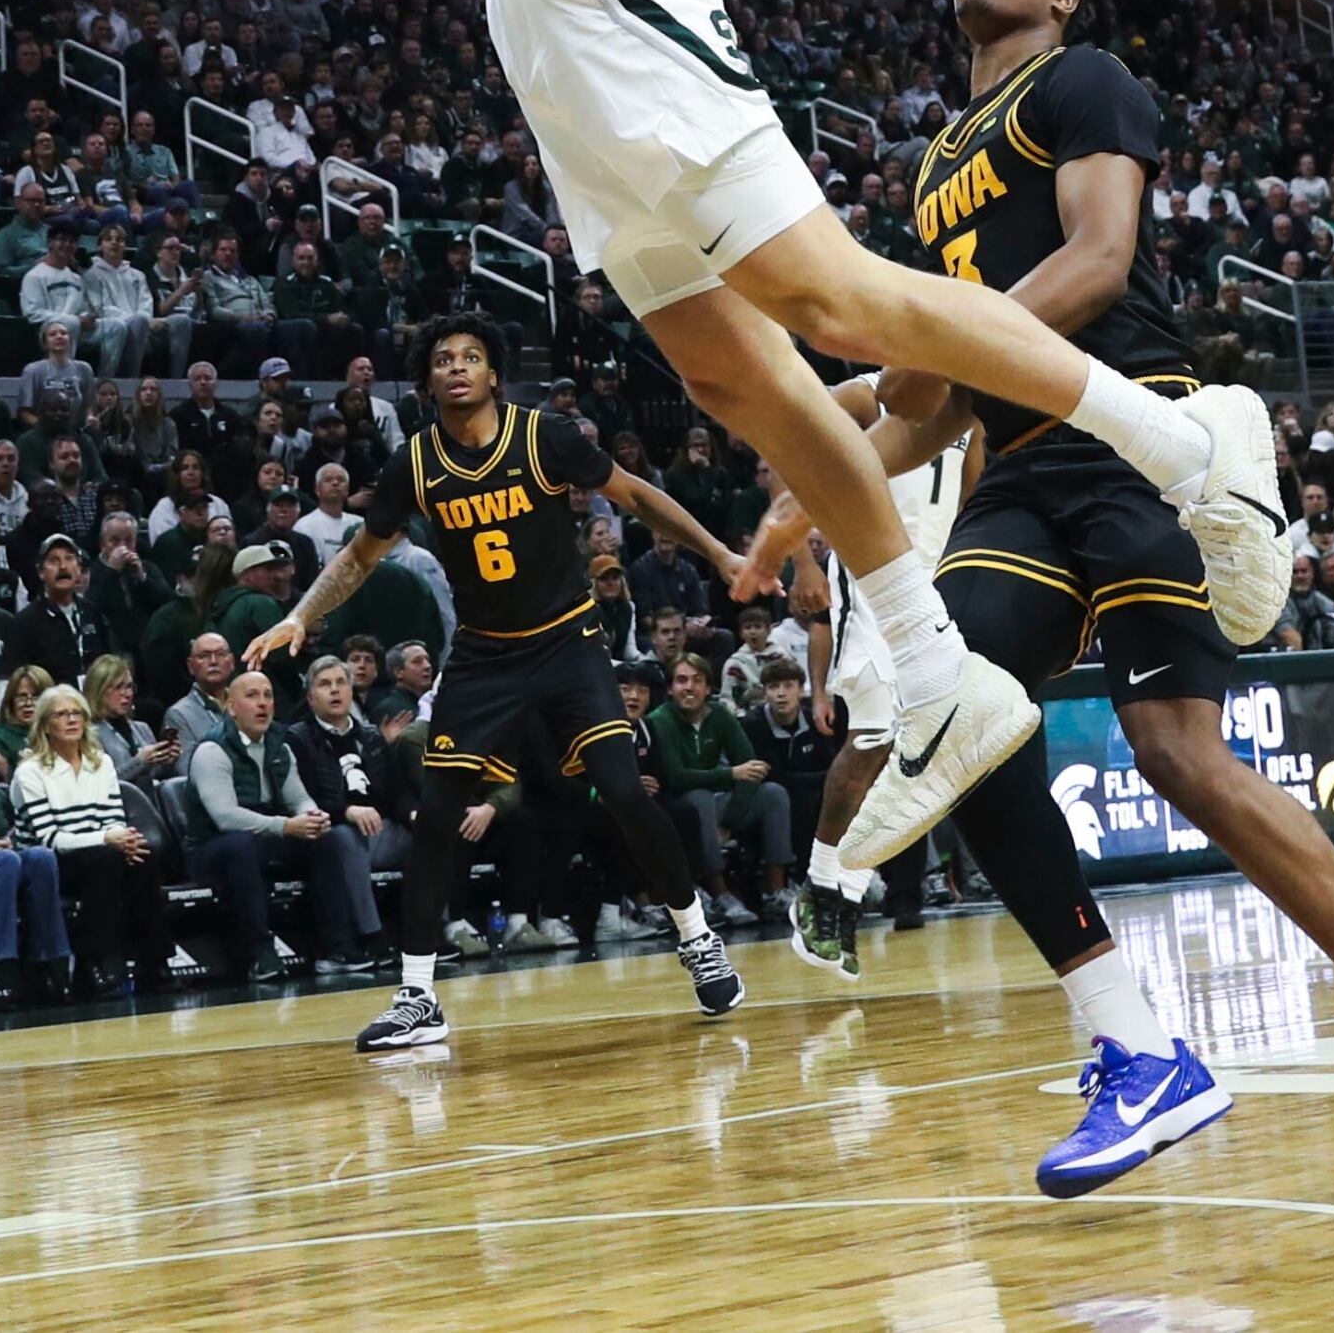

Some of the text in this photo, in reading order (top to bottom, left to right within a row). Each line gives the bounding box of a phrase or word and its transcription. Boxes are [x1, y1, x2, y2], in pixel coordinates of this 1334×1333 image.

[918, 148, 1008, 245] OWA
[435, 485, 534, 530] IOWA
[473, 529, 517, 583] 6
